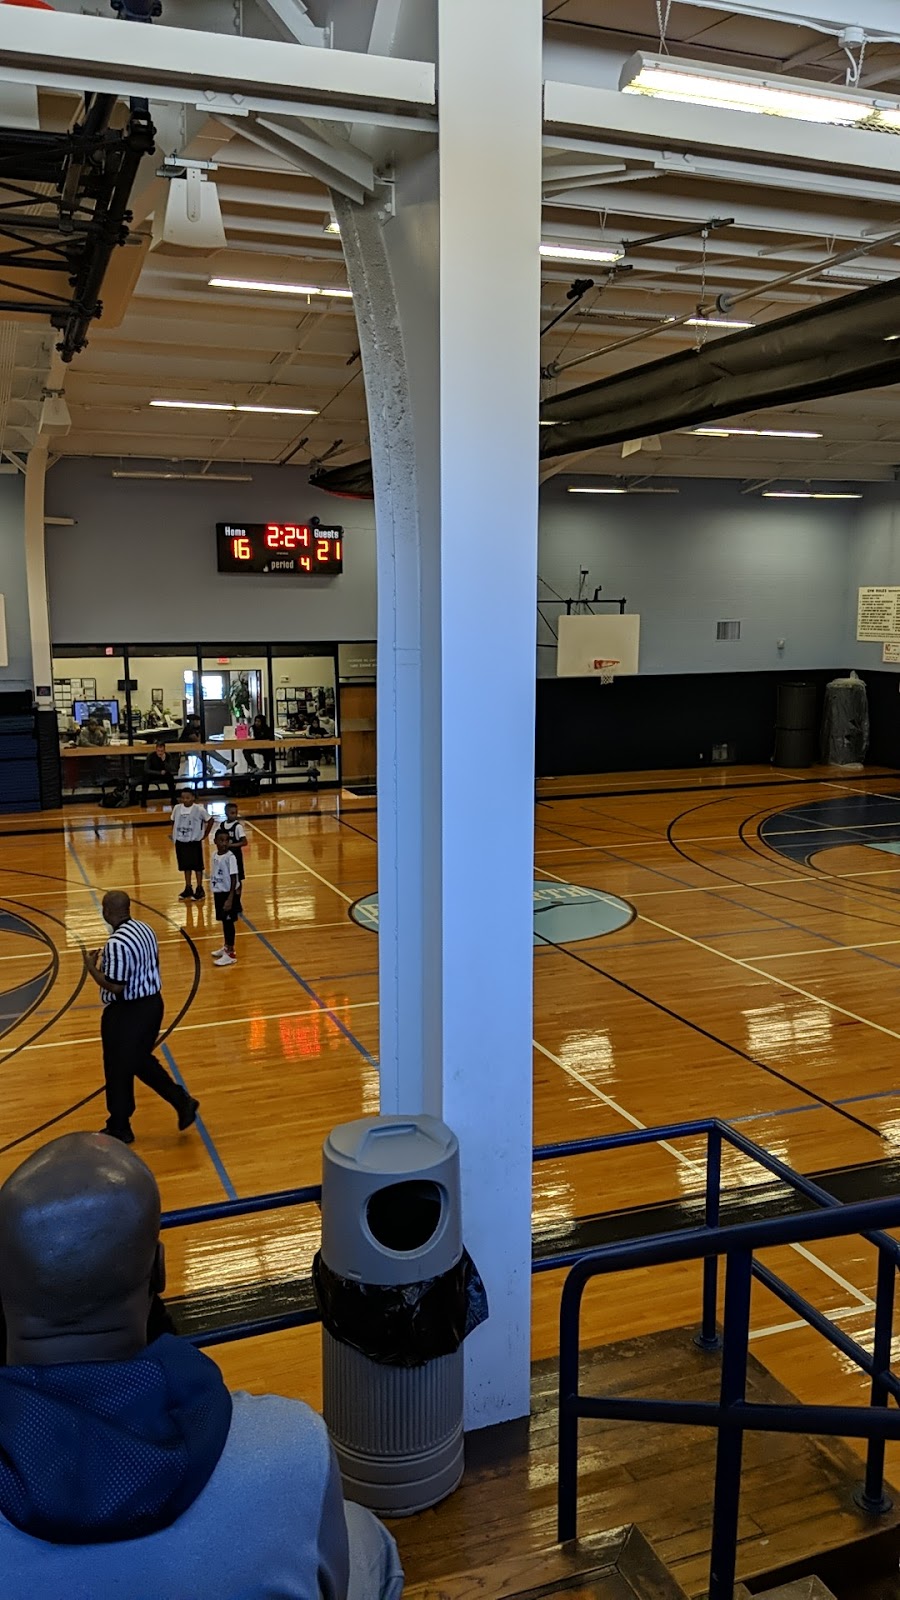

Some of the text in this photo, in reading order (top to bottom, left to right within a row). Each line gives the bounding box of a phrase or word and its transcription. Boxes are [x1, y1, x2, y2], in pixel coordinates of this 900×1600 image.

[225, 526, 246, 536] Home
[267, 526, 308, 547] 2:24
[314, 528, 339, 539] Guests
[233, 539, 250, 559] 16
[317, 540, 341, 560] 21
[271, 560, 294, 570] period
[300, 557, 310, 571] 4
[533, 887, 590, 900] RTH
